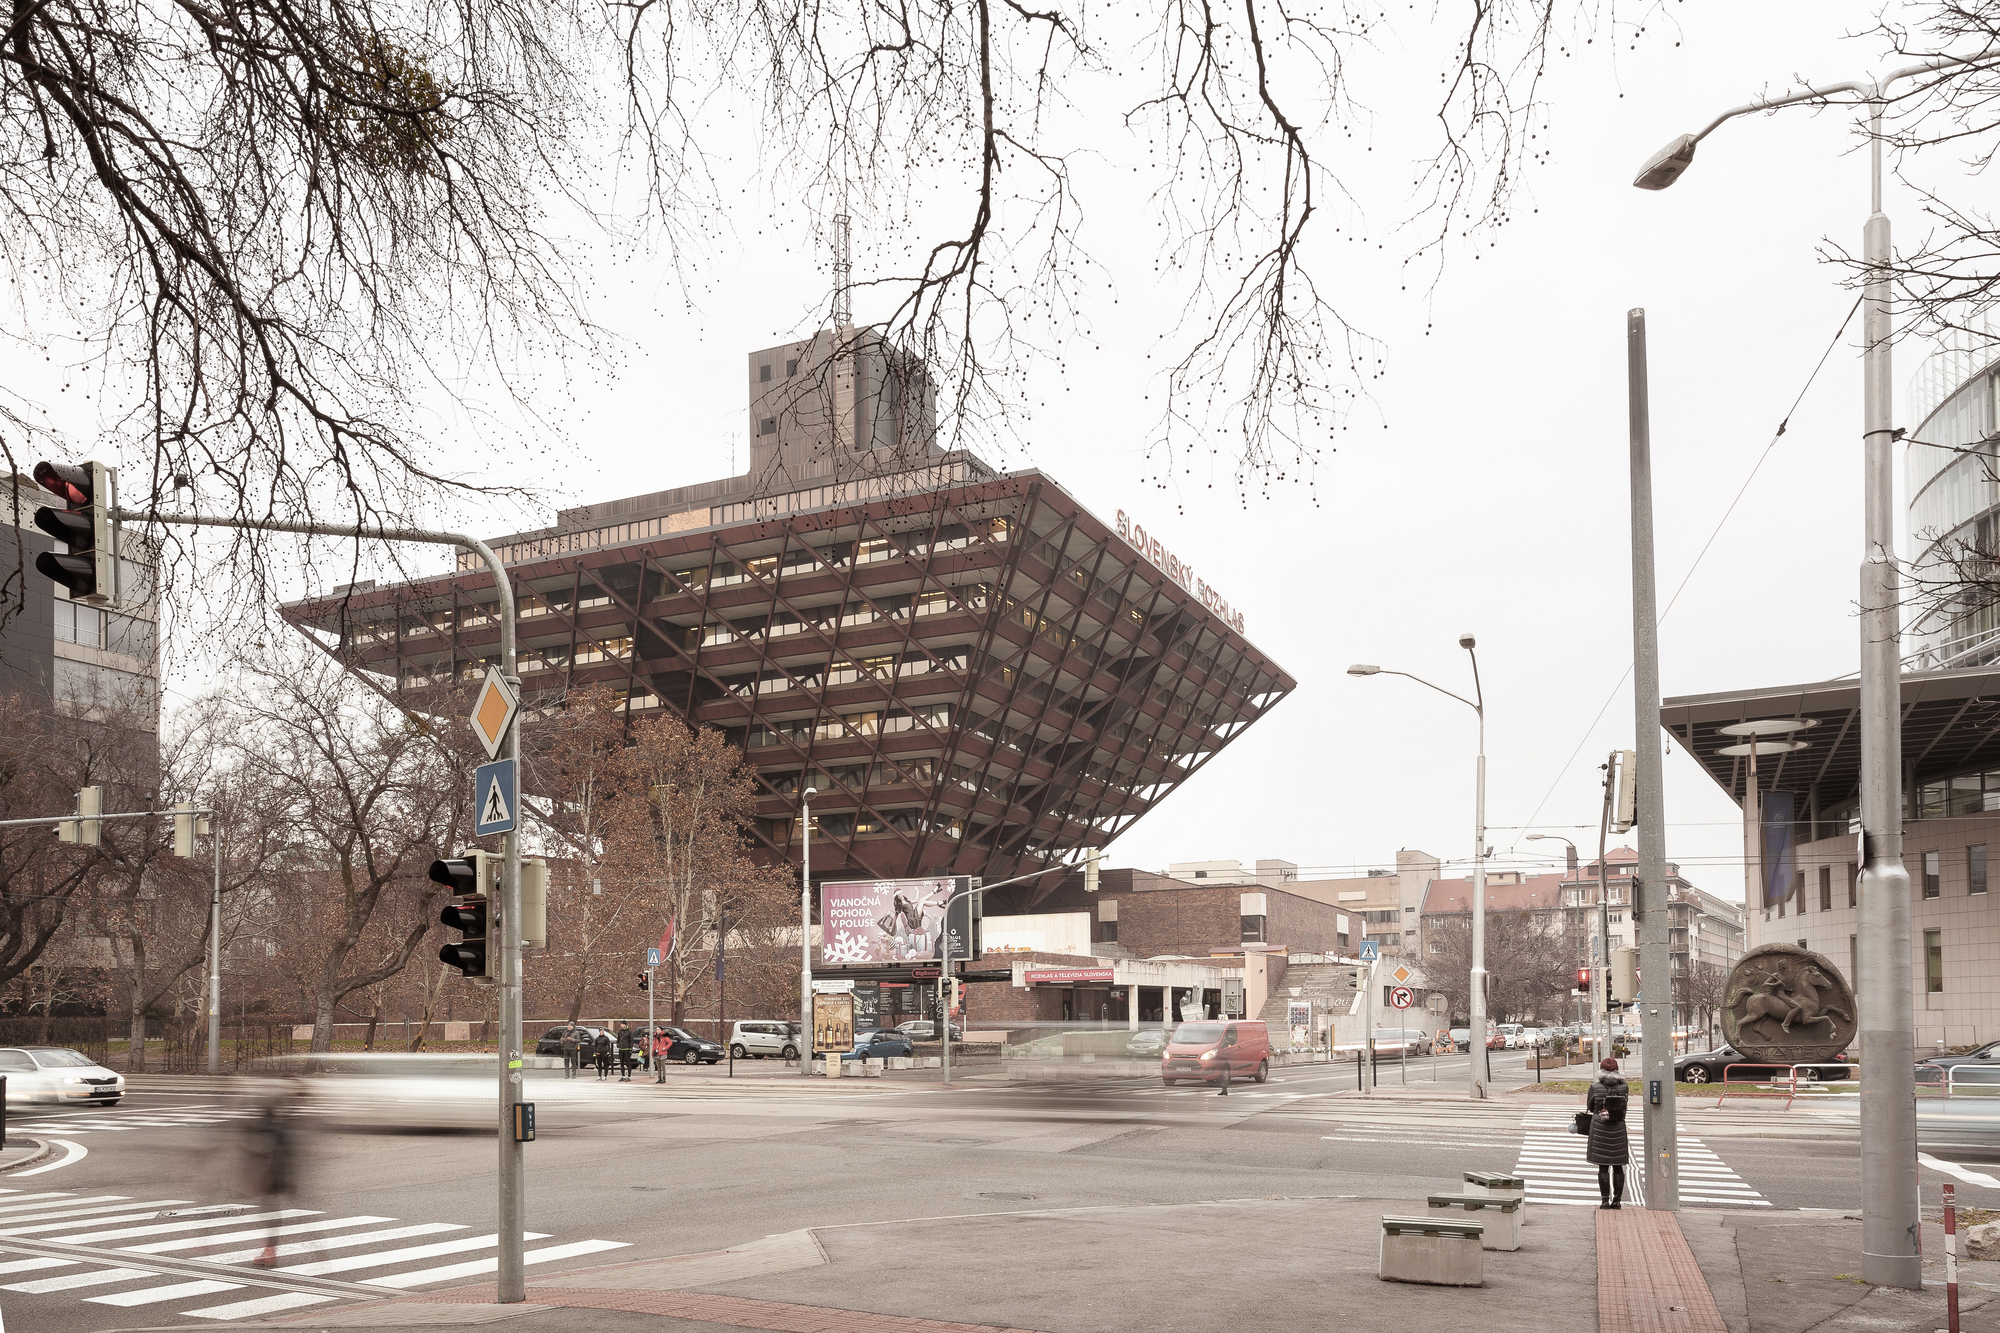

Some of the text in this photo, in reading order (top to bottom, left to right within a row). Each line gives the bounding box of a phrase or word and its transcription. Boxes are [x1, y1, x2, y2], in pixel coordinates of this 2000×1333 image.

[1117, 509, 1244, 634] SLOVENSKÝ ROZHLAS
[830, 896, 881, 907] VIANOČNÁ
[830, 908, 872, 918] POHODA
[830, 919, 875, 928] V POLUSE
[1750, 1046, 1828, 1060] BIATEC
